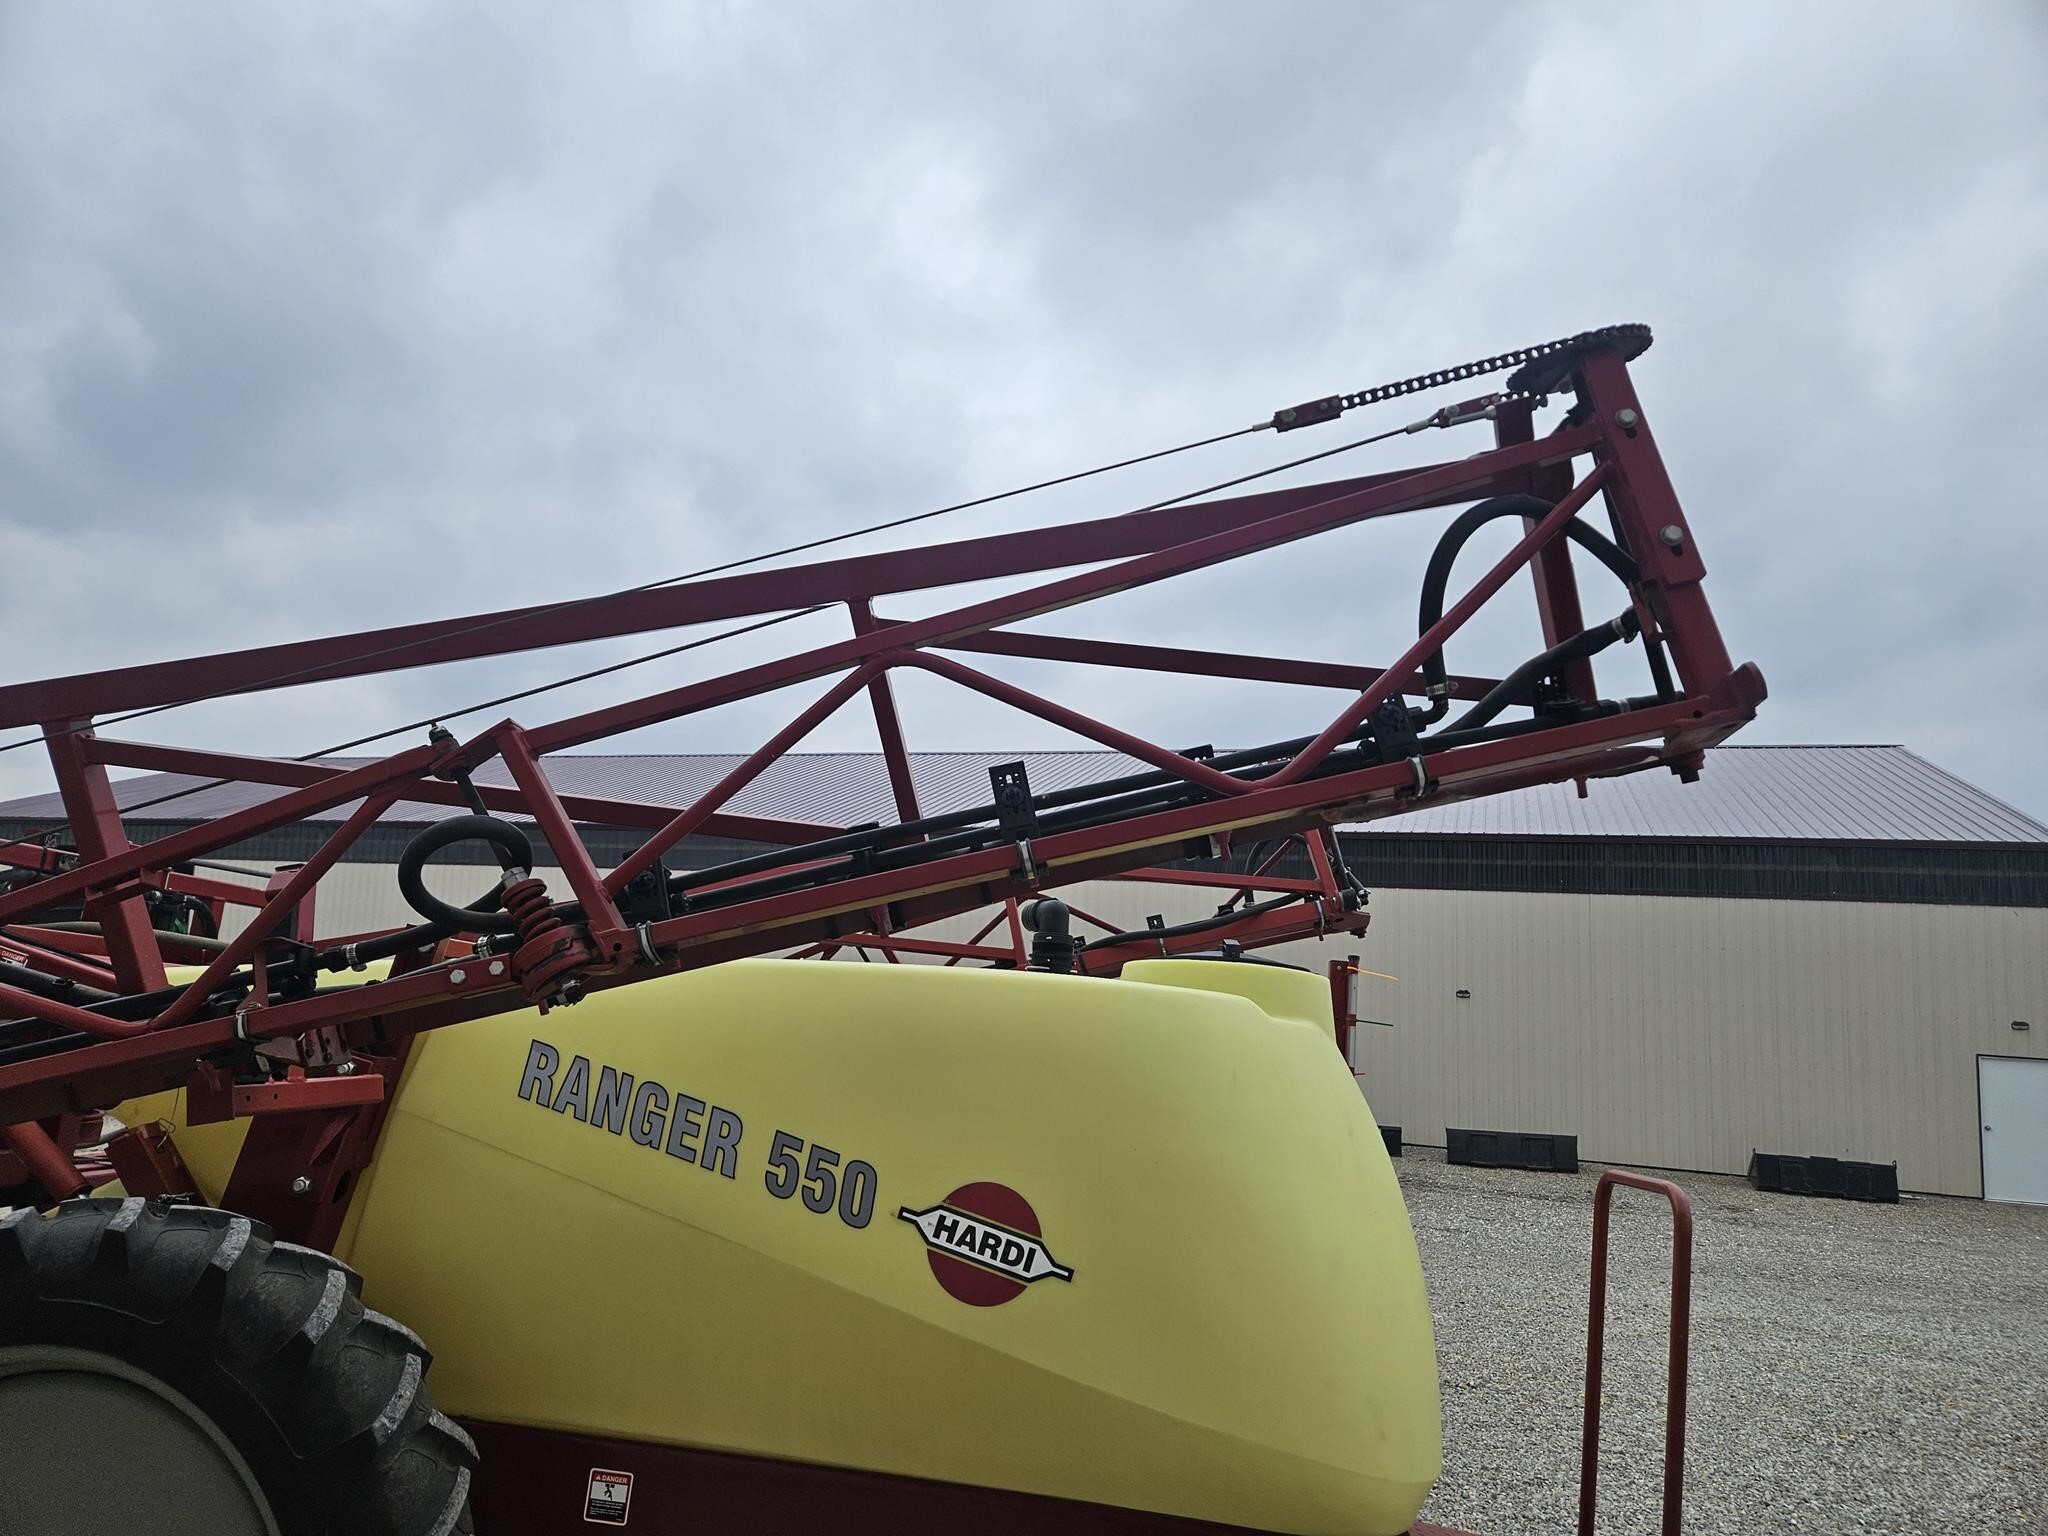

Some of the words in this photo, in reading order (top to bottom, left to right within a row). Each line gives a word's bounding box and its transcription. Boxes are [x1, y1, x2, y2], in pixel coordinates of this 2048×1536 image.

[1, 950, 25, 962] DANGER
[518, 1039, 743, 1180] RANGER
[765, 1130, 878, 1229] 550
[932, 1214, 1037, 1273] HARDI
[602, 1474, 628, 1484] DANGER
